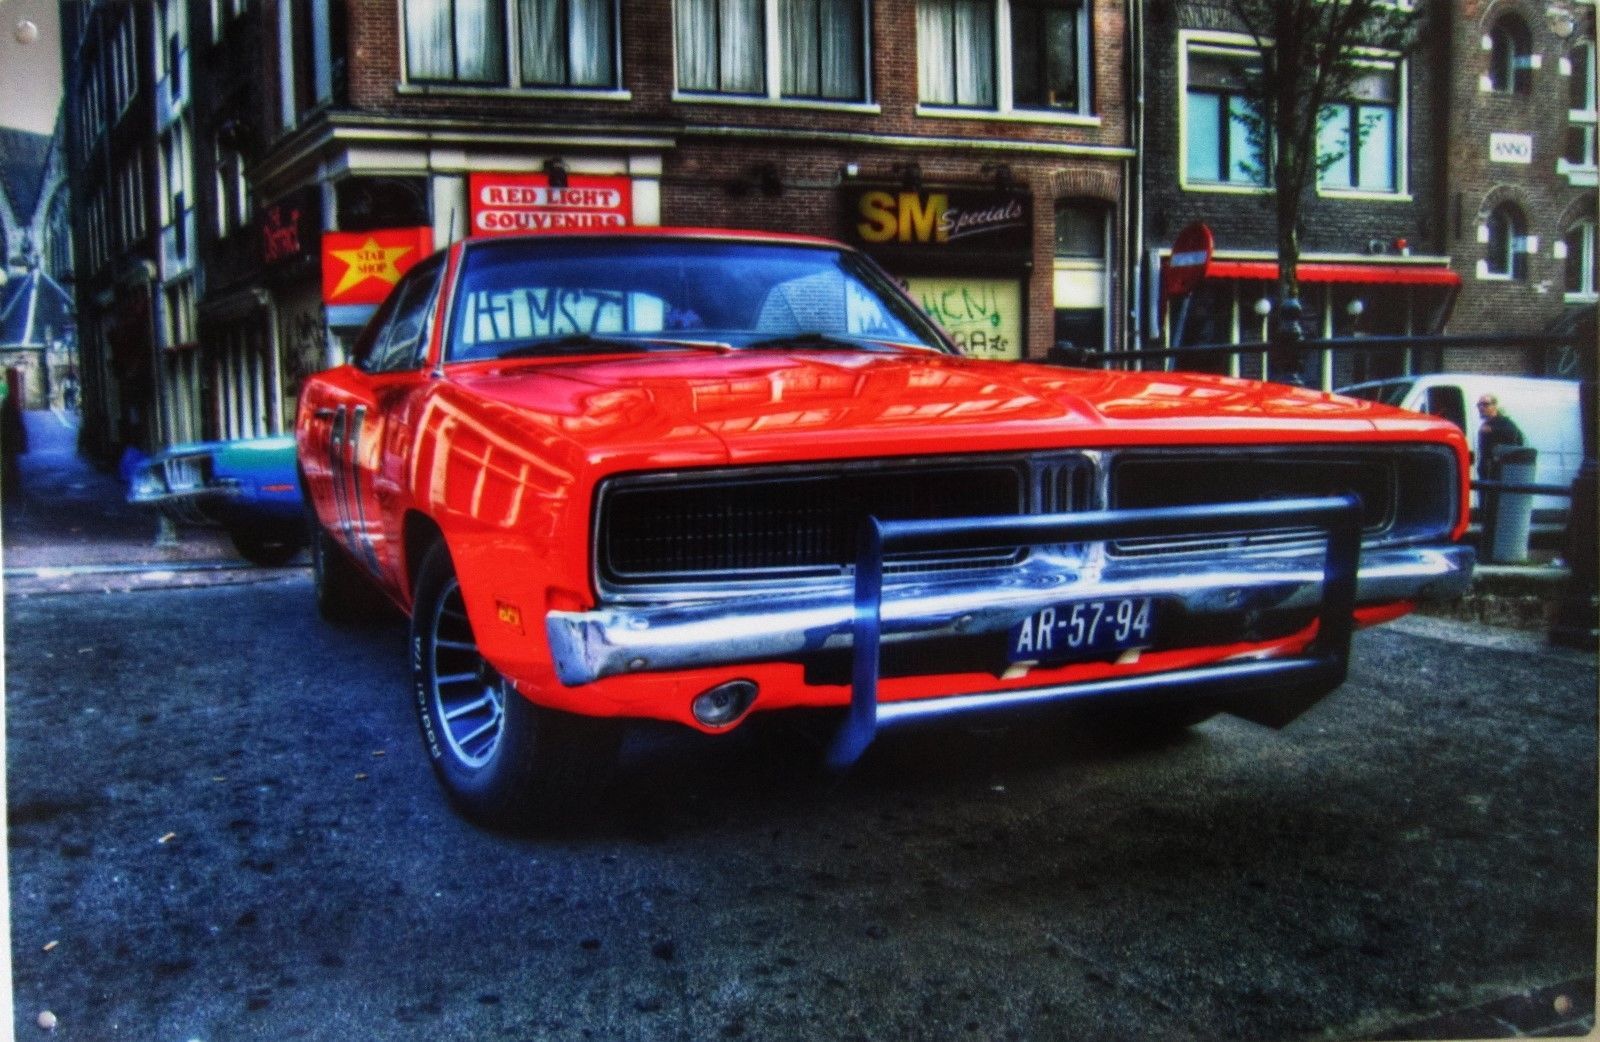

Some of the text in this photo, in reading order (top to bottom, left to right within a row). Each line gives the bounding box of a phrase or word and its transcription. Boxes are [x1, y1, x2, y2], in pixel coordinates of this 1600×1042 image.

[489, 188, 613, 206] RED LIGHT
[857, 191, 1022, 243] SM Specials
[358, 250, 386, 260] STAR
[358, 263, 387, 273] SHOP
[1015, 599, 1151, 652] AR-57-94
